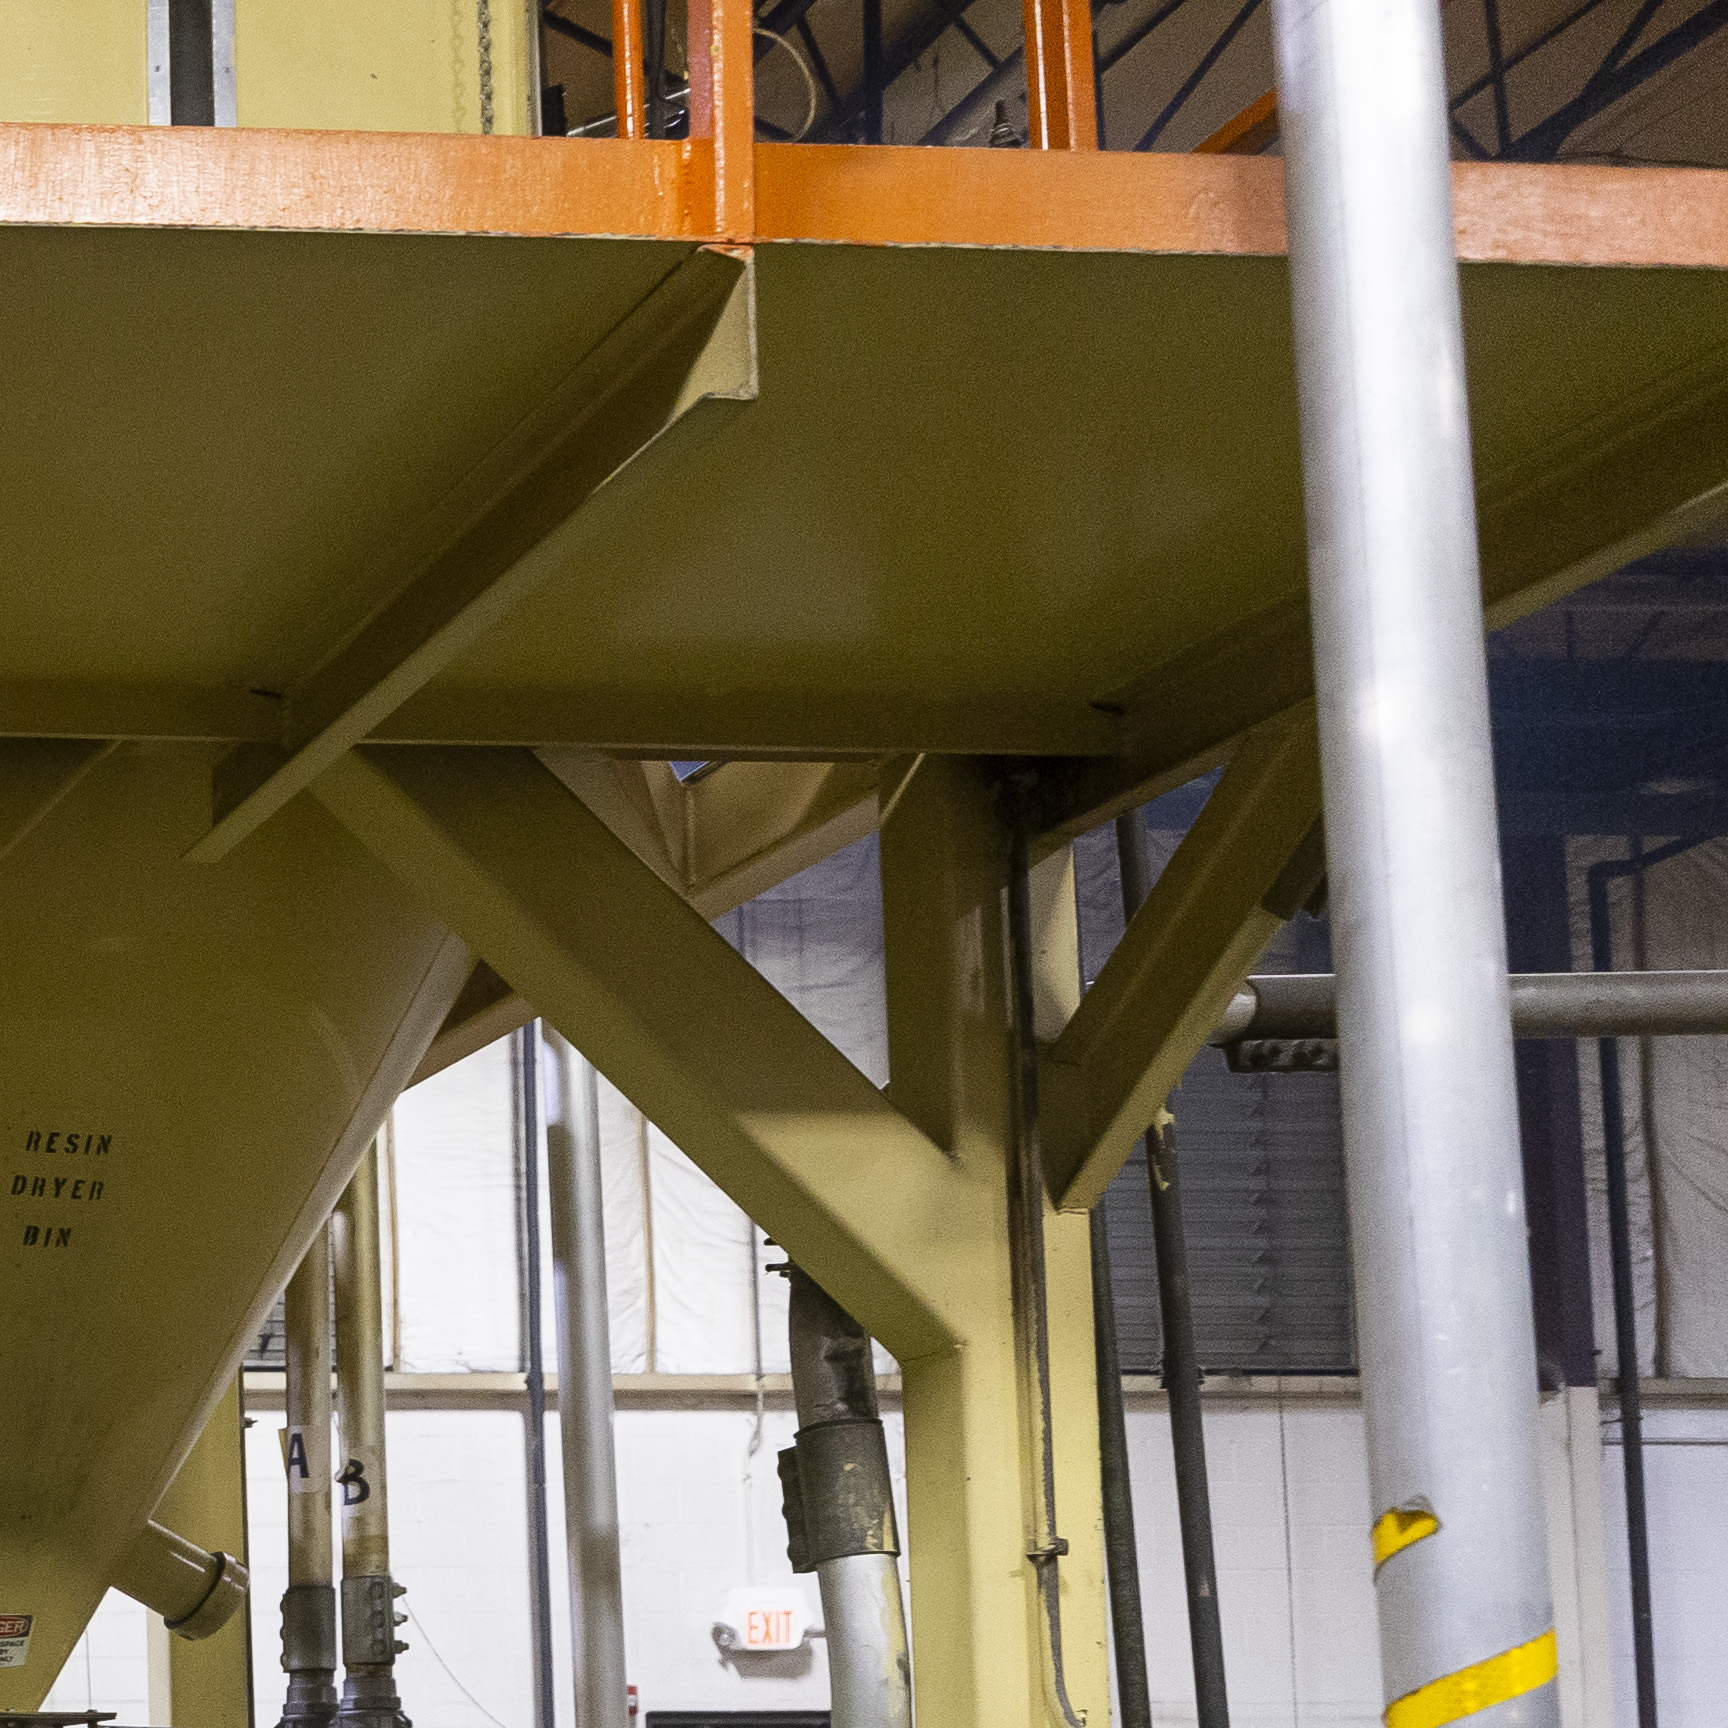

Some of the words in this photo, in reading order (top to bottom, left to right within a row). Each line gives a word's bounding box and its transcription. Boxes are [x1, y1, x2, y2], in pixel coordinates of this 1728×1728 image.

[25, 1131, 112, 1155] RESIN
[10, 1175, 104, 1200] DRYER
[23, 1225, 72, 1247] BIN
[288, 1433, 310, 1478] A
[336, 1459, 370, 1506] B
[748, 1611, 793, 1644] EXIT
